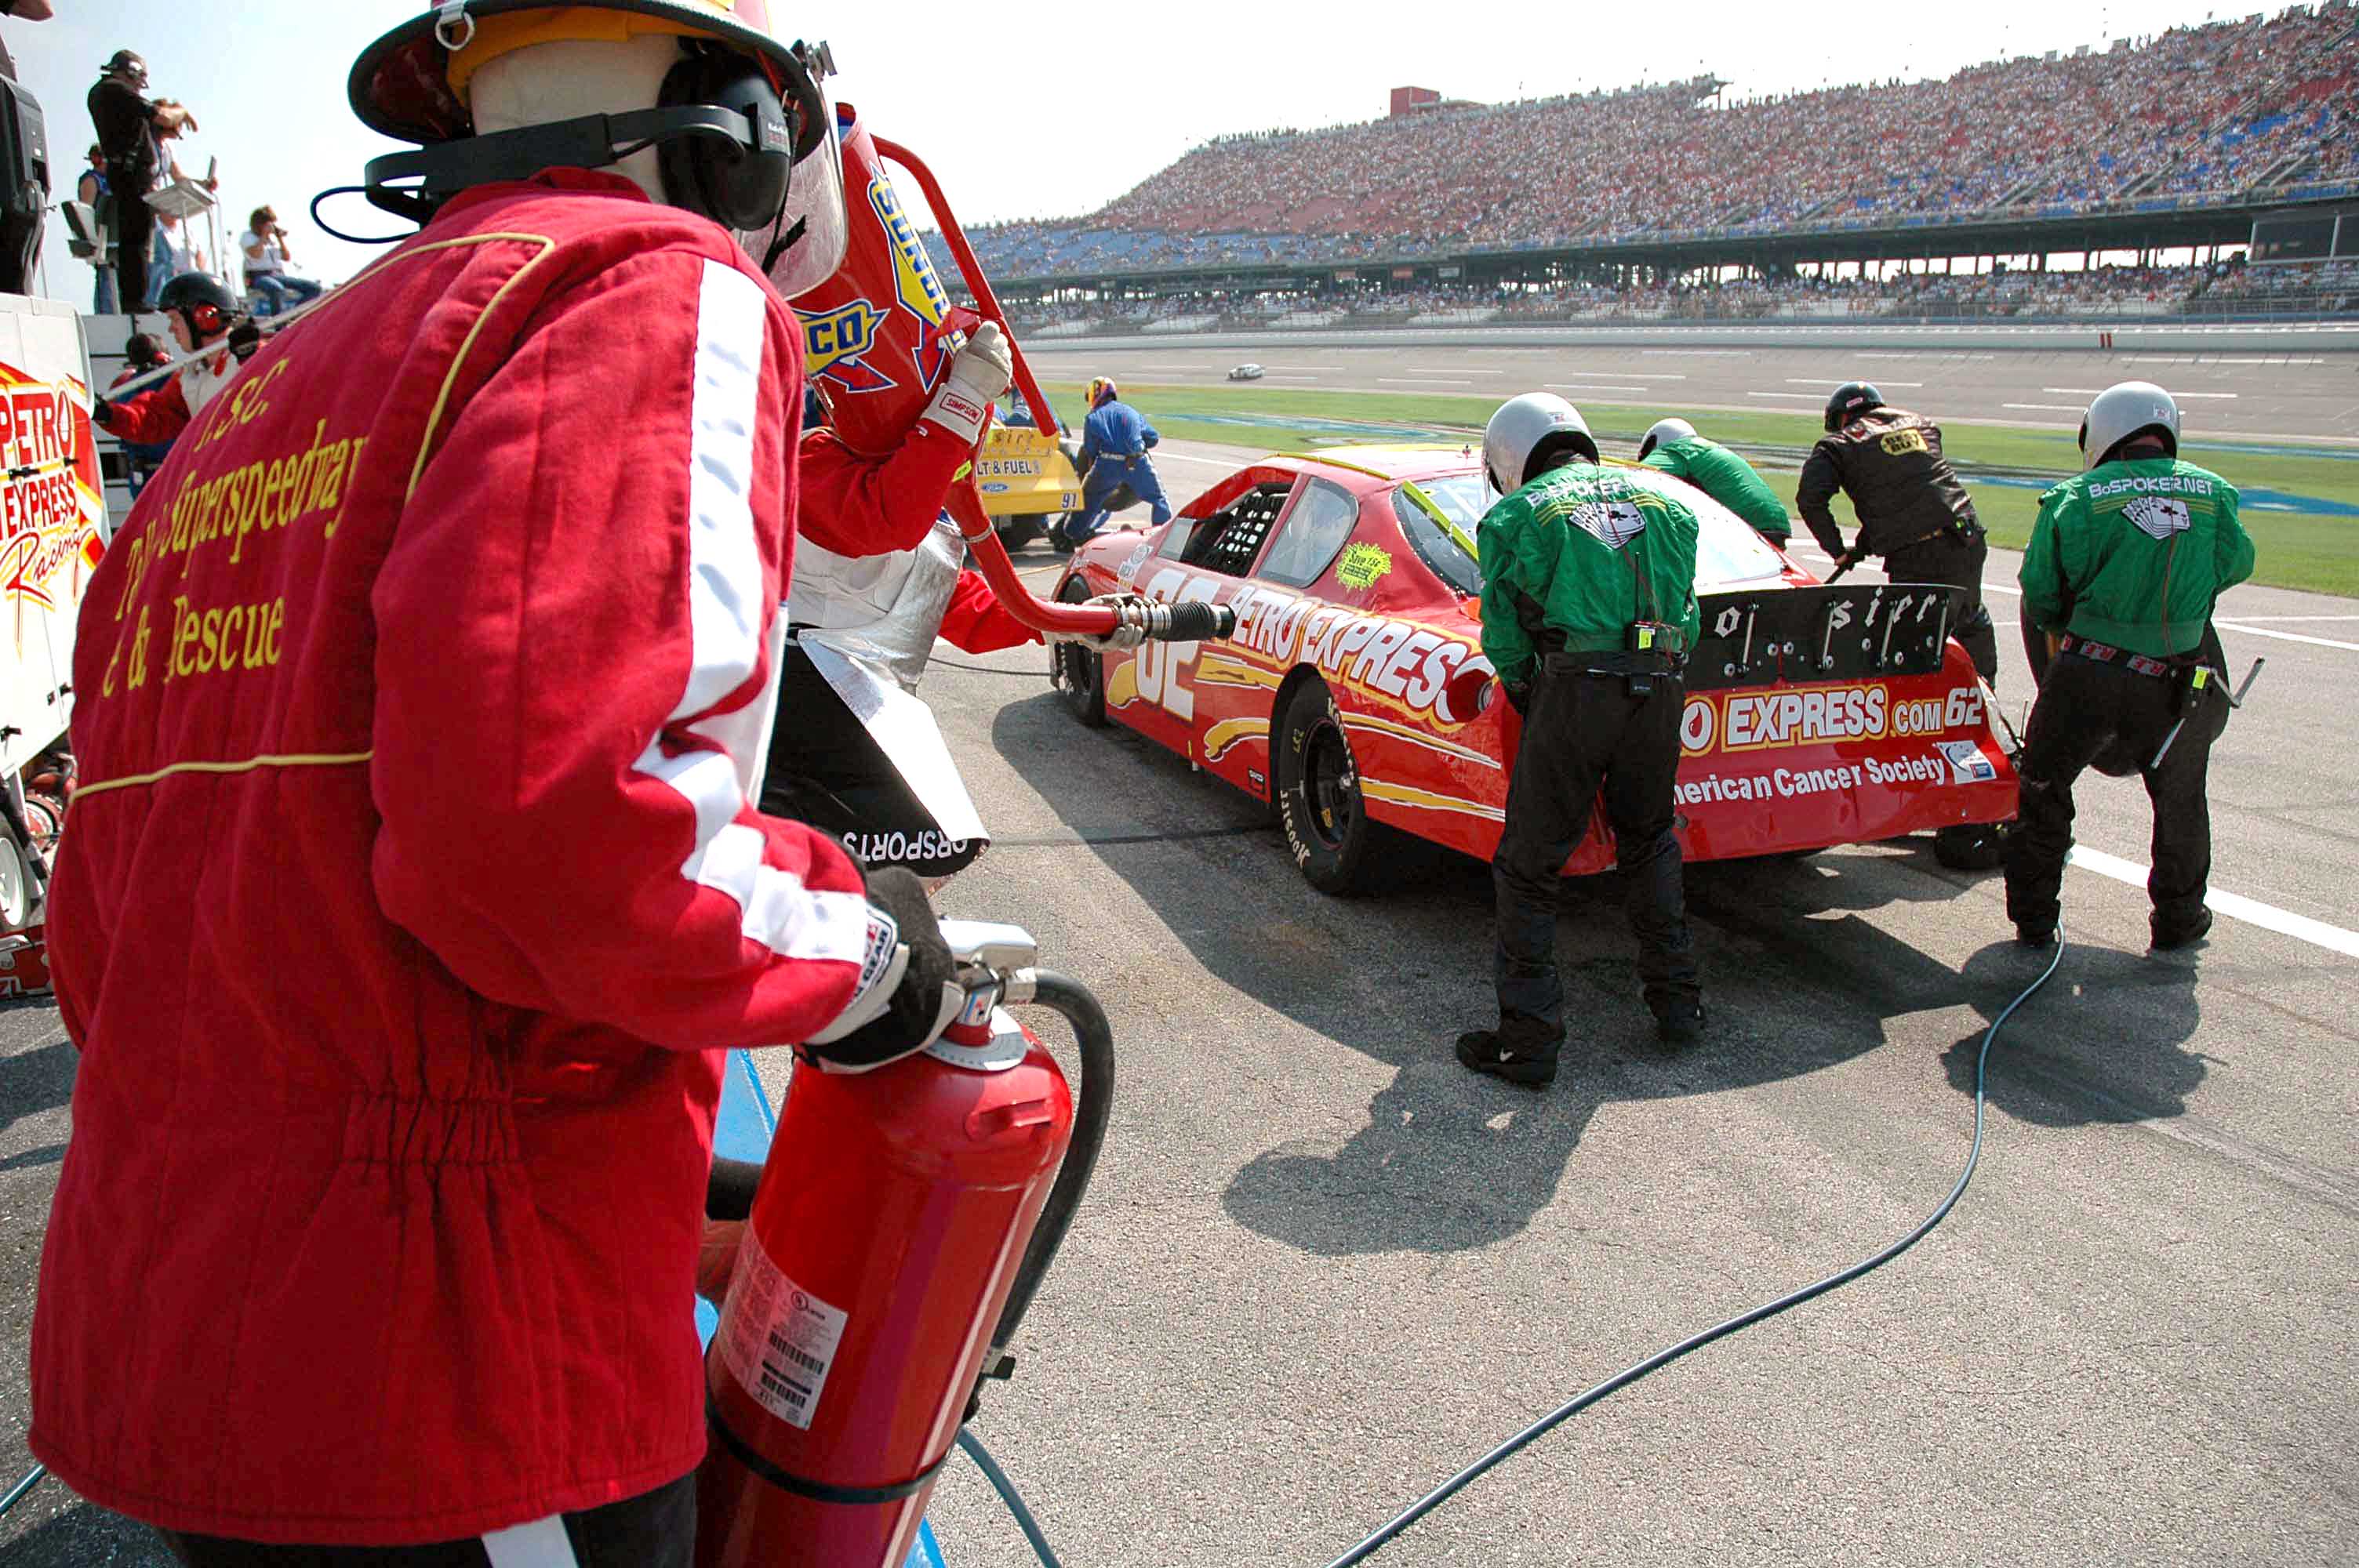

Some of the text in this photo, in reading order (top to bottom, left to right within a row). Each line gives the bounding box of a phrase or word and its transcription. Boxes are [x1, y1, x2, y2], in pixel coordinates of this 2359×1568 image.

[946, 397, 980, 419] SIMPSON
[993, 461, 1001, 474] &
[1004, 460, 1032, 474] FUEL
[4, 472, 76, 538] EXPRESS
[1061, 493, 1077, 508] 91
[0, 528, 94, 643] Racing
[1228, 585, 1314, 661] PETRO
[1726, 688, 1886, 746] EXPRESS
[1943, 687, 1983, 727] 62
[1773, 764, 1861, 797] Cancer
[1863, 755, 1946, 786] Society
